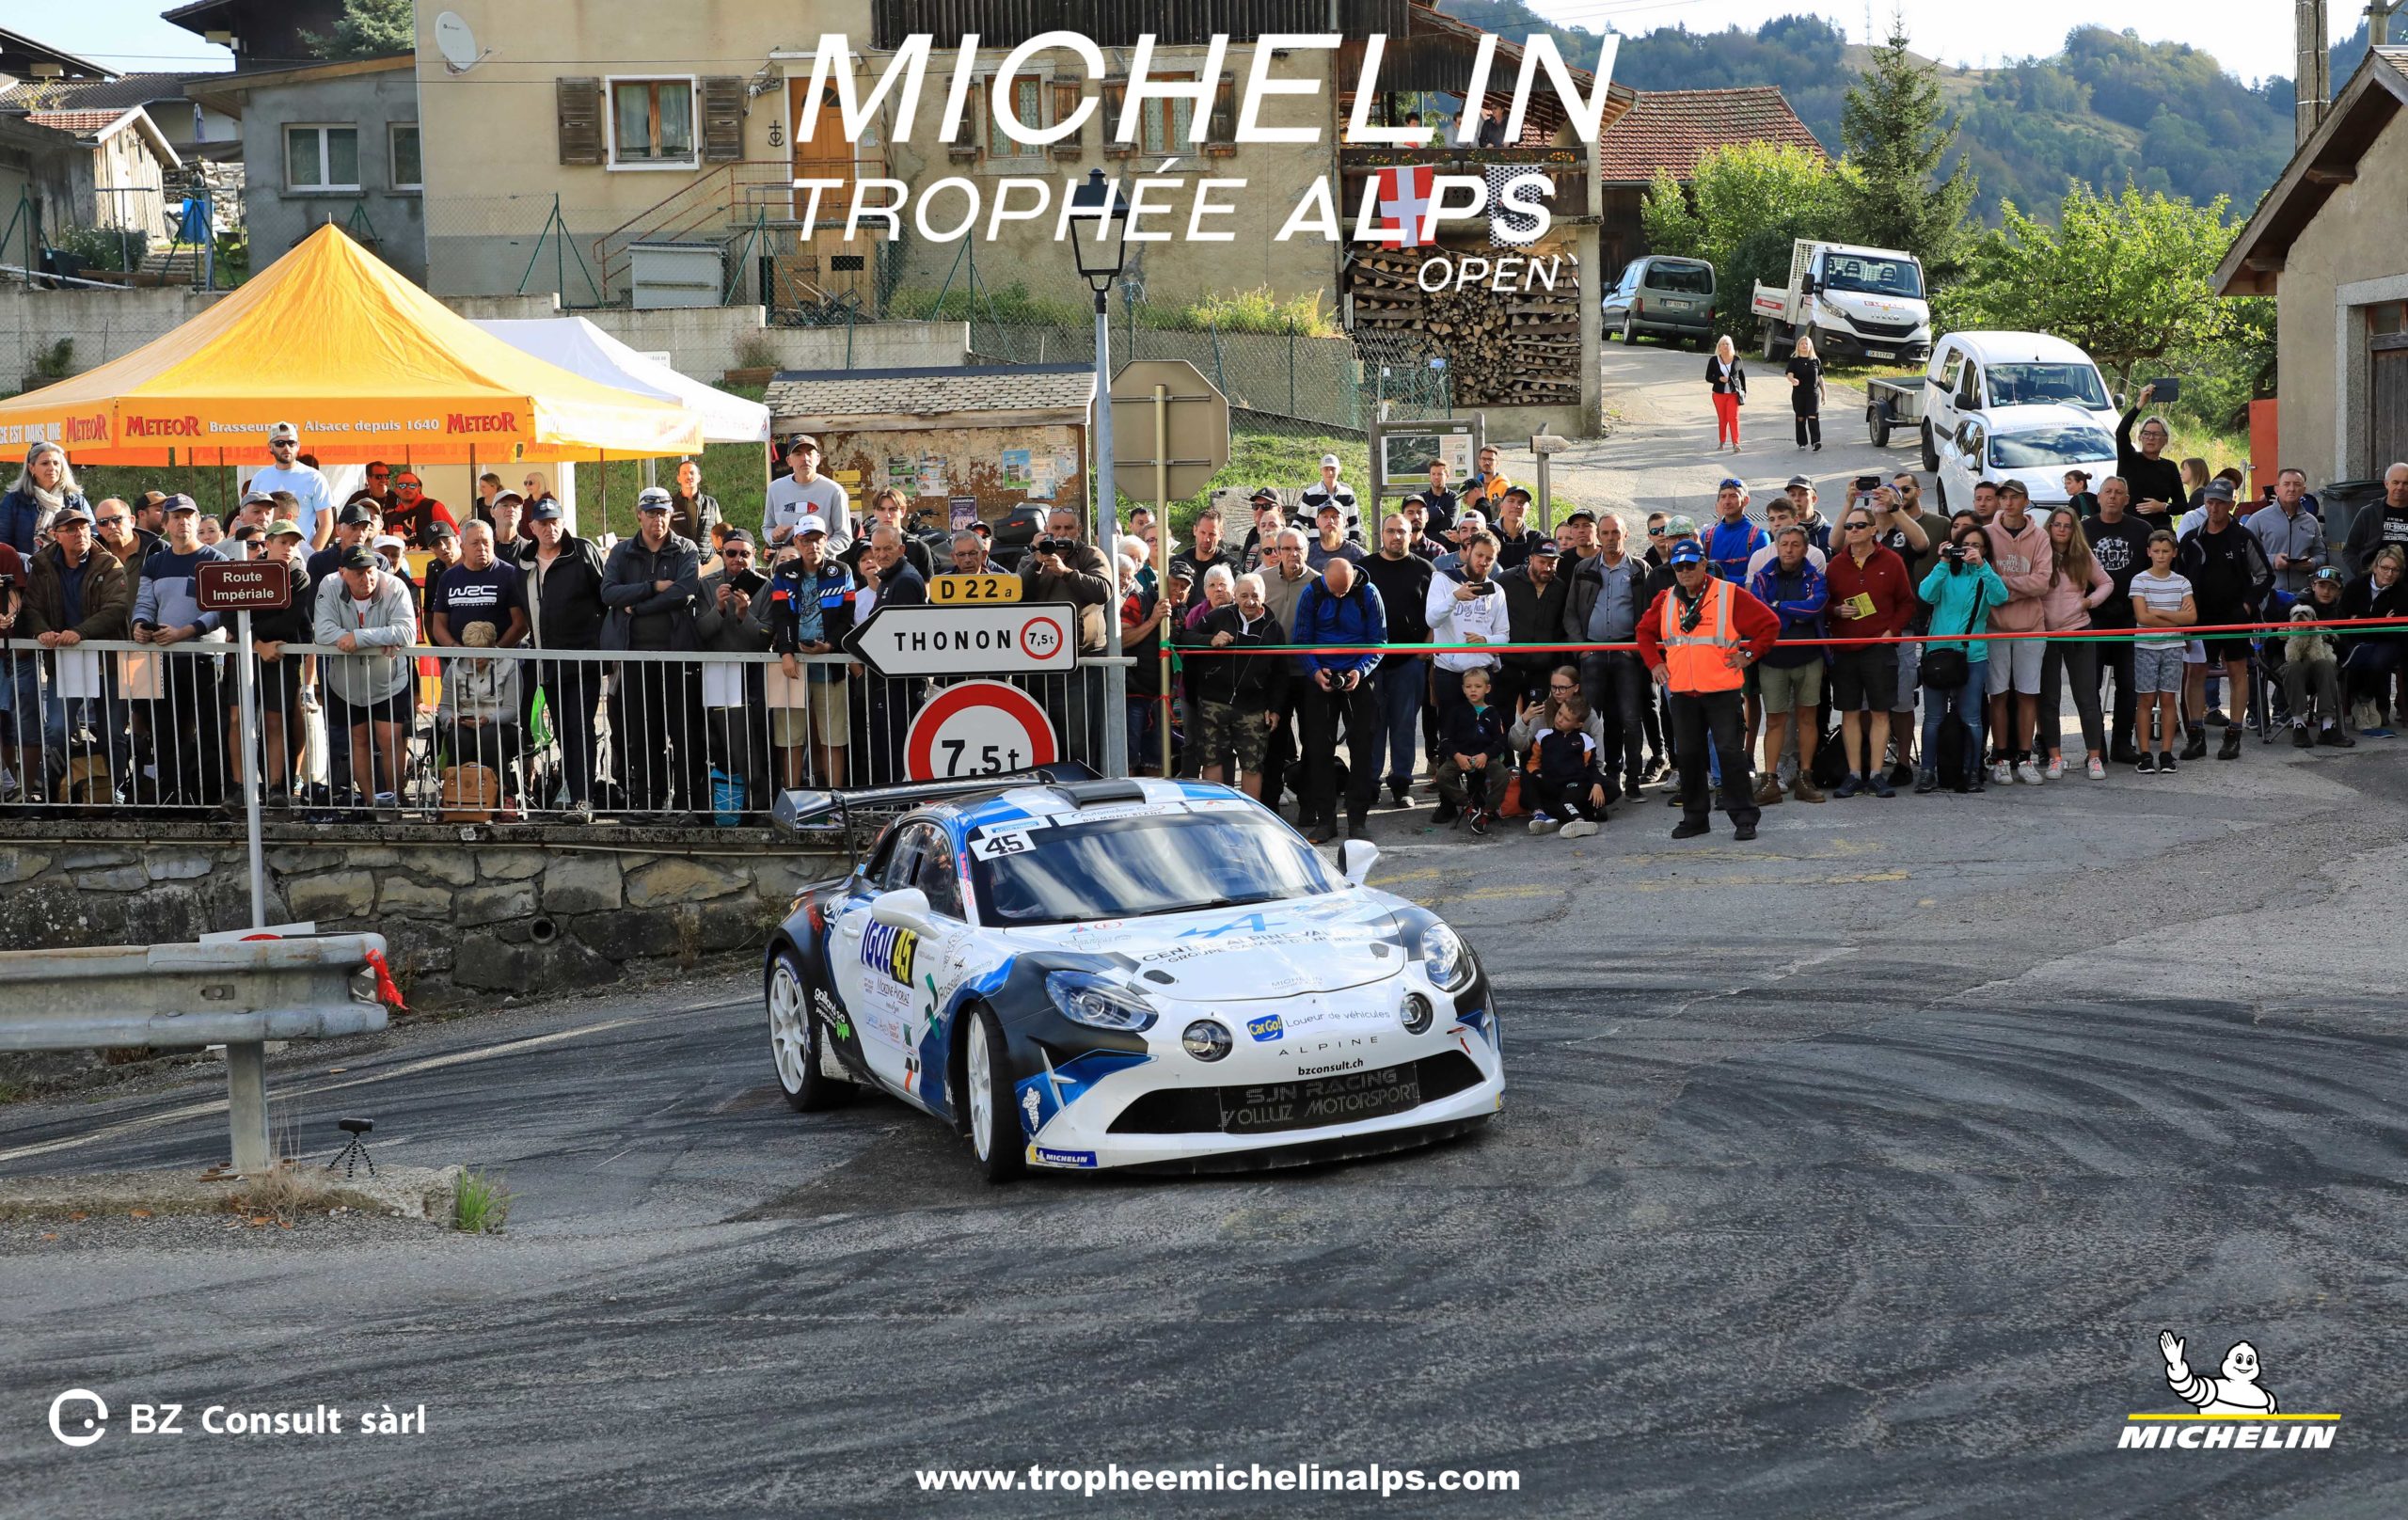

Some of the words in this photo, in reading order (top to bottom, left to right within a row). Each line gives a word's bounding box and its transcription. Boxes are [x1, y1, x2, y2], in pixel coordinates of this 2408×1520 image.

[9, 424, 23, 445] EST
[47, 421, 61, 441] UNE
[66, 413, 108, 443] METEOR
[125, 415, 201, 437] METEOR
[304, 420, 350, 433] Alsace
[354, 420, 402, 434] depuis
[405, 419, 439, 431] 1640
[446, 411, 517, 435] METEOR
[223, 572, 262, 582] Route
[213, 588, 275, 602] Impériale
[449, 585, 498, 597] WRC
[941, 580, 955, 599] D
[894, 629, 1011, 652] THONON
[985, 833, 1025, 855] 45
[860, 916, 897, 975] IGOL
[894, 927, 917, 985] 45
[1142, 942, 1222, 962] CENTRE
[1228, 933, 1295, 945] ALPINE
[1167, 947, 1227, 963] GROUPE
[1285, 1013, 1324, 1027] Loueur
[1328, 1011, 1340, 1020] de
[1344, 1009, 1390, 1019] véhicules
[1278, 1037, 1378, 1056] ALPINE
[1298, 1058, 1364, 1076] bzconsult.ch
[1246, 1085, 1298, 1104] SJN
[1306, 1069, 1397, 1098] RACING
[1305, 1082, 1418, 1117] MOTORSPORT
[1046, 1153, 1087, 1164] MICHELIN
